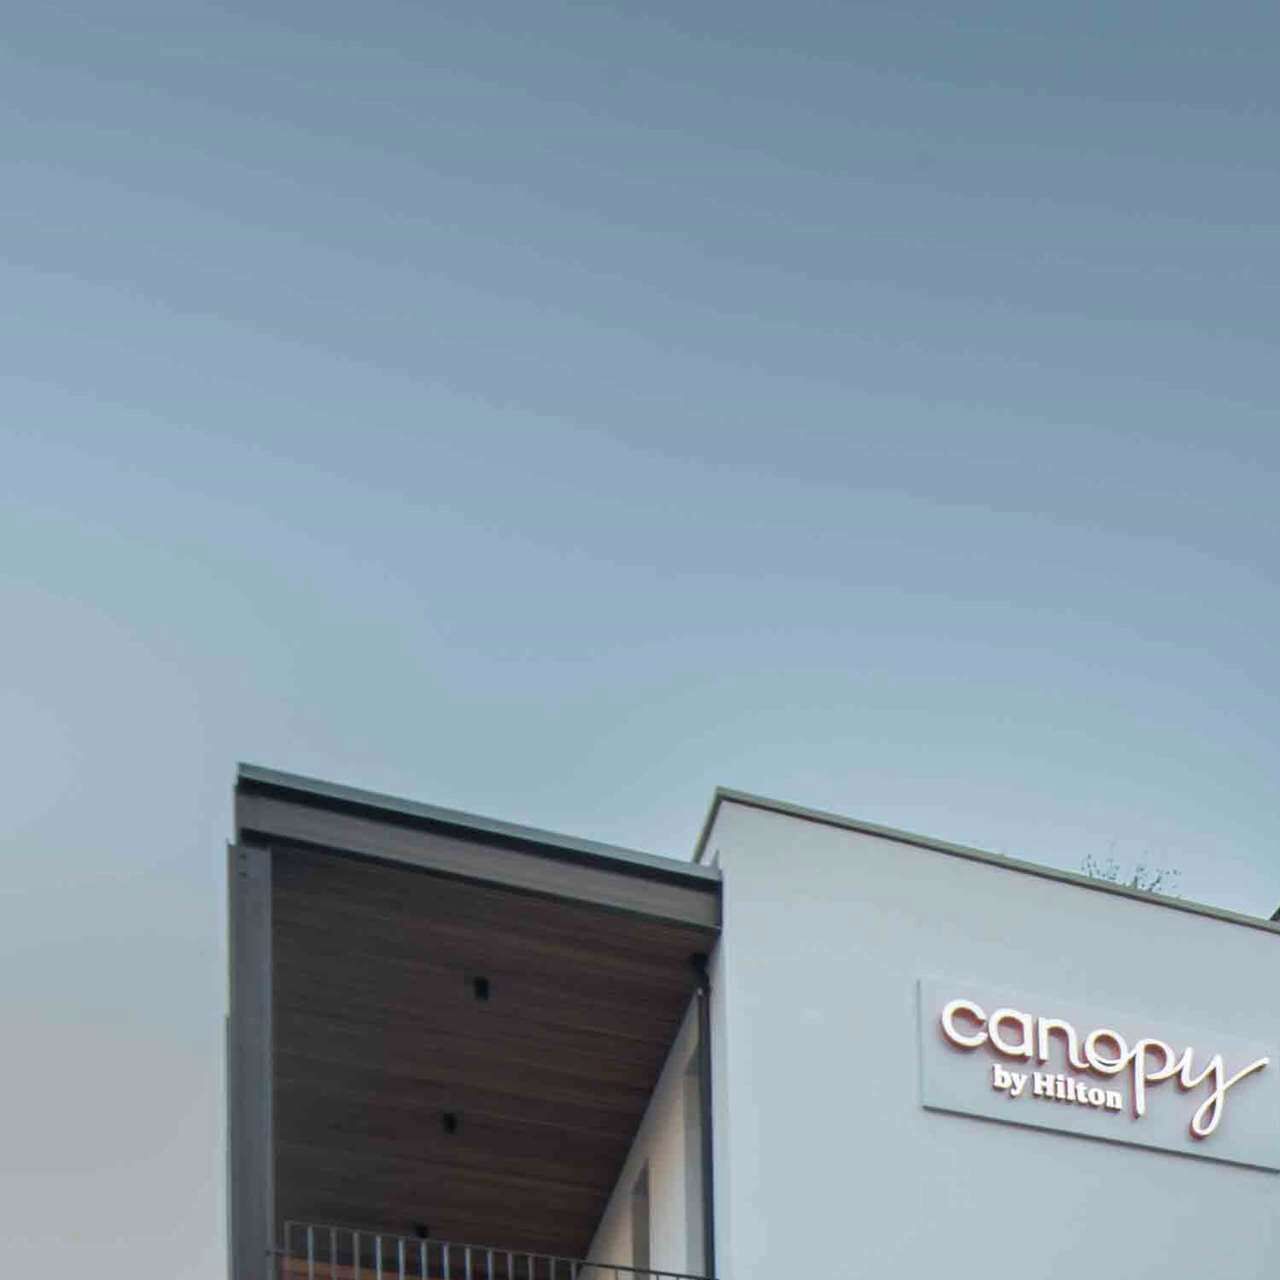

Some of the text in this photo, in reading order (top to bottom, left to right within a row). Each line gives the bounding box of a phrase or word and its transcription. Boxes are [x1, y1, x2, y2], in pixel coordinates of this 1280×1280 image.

[941, 998, 1270, 1137] canopy
[992, 1065, 1123, 1111] by Hilton
